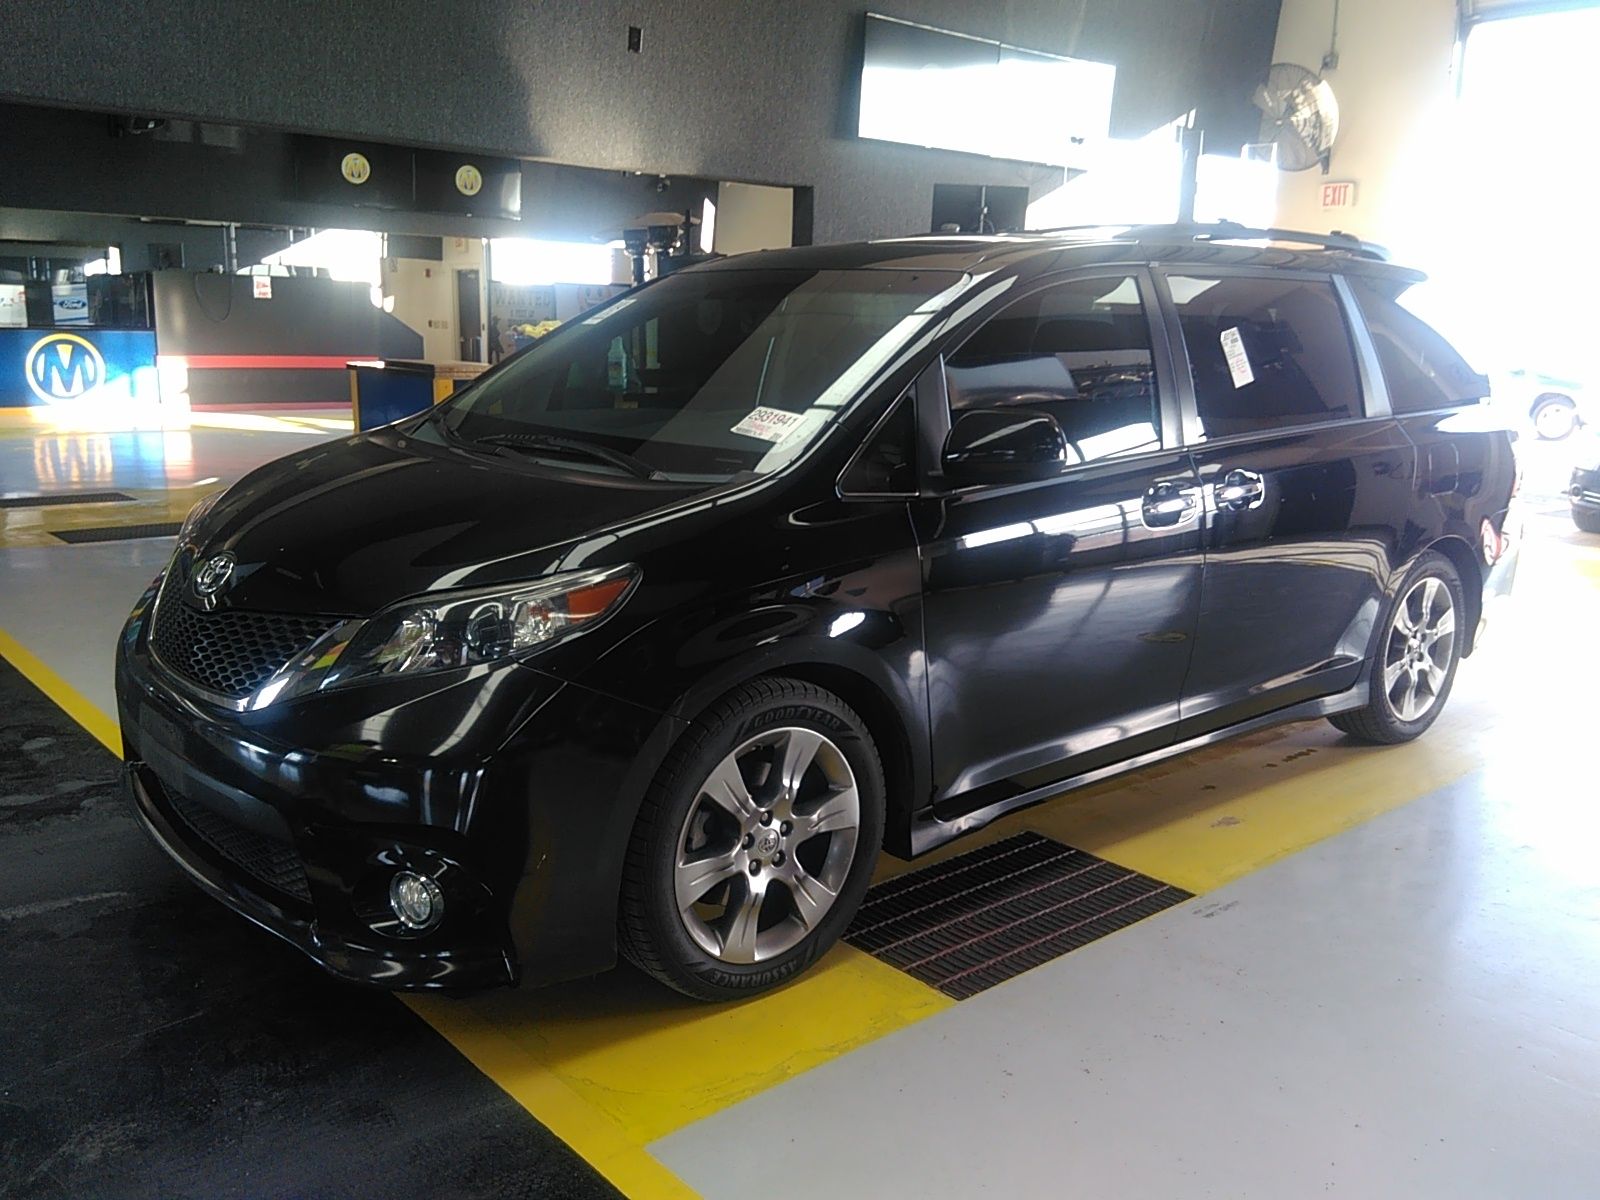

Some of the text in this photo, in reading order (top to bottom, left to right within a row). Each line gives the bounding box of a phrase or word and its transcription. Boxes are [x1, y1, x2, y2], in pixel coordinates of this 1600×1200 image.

[1322, 185, 1349, 206] EXIT
[494, 287, 550, 305] WANTED
[34, 341, 98, 397] M
[753, 706, 840, 728] GOODYEAR
[711, 961, 797, 987] ASSURANCE
